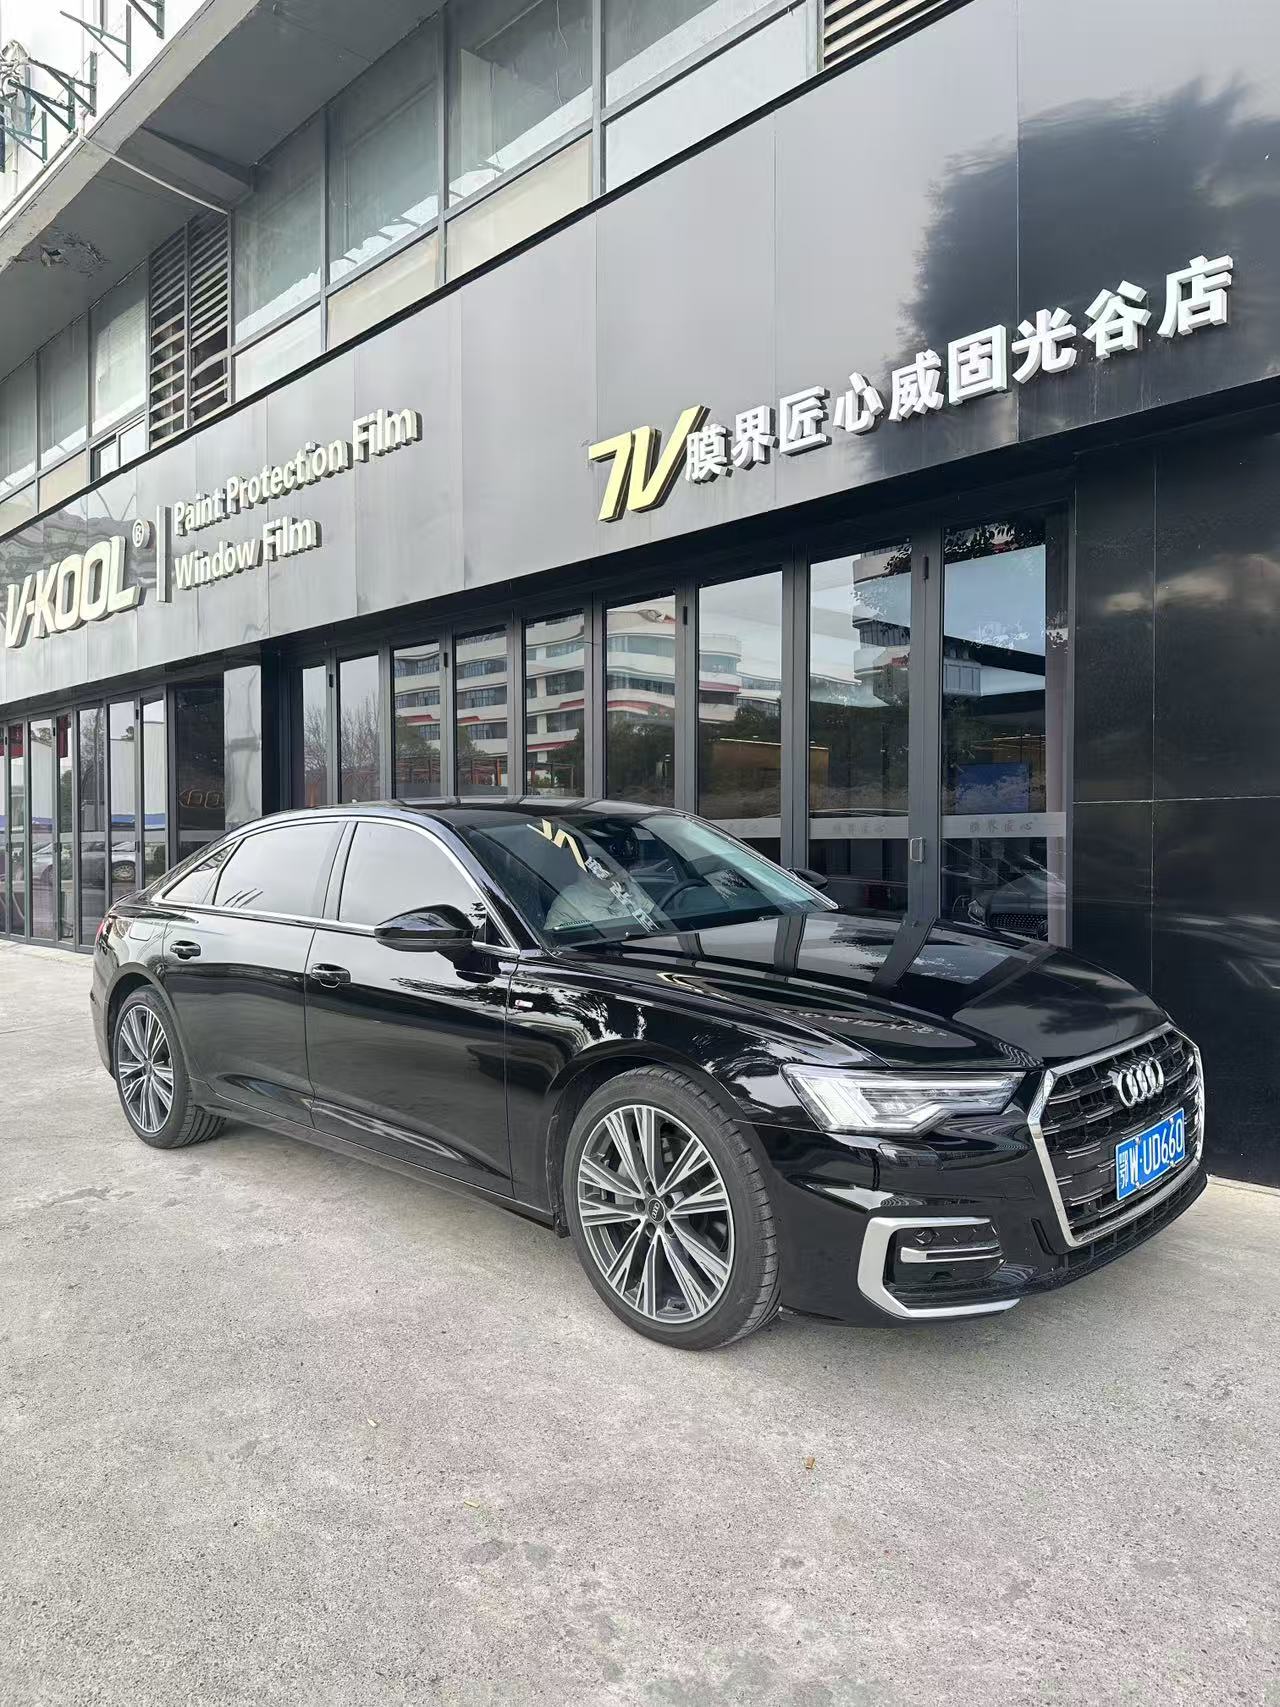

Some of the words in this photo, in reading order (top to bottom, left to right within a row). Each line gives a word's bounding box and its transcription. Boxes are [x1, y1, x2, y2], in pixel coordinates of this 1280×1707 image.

[685, 255, 1235, 483] 膜界匠心威固光谷店
[174, 487, 227, 535] Paint
[226, 440, 352, 514] Protection
[353, 408, 422, 462] Film
[175, 539, 262, 590] Window
[263, 516, 322, 561] Film
